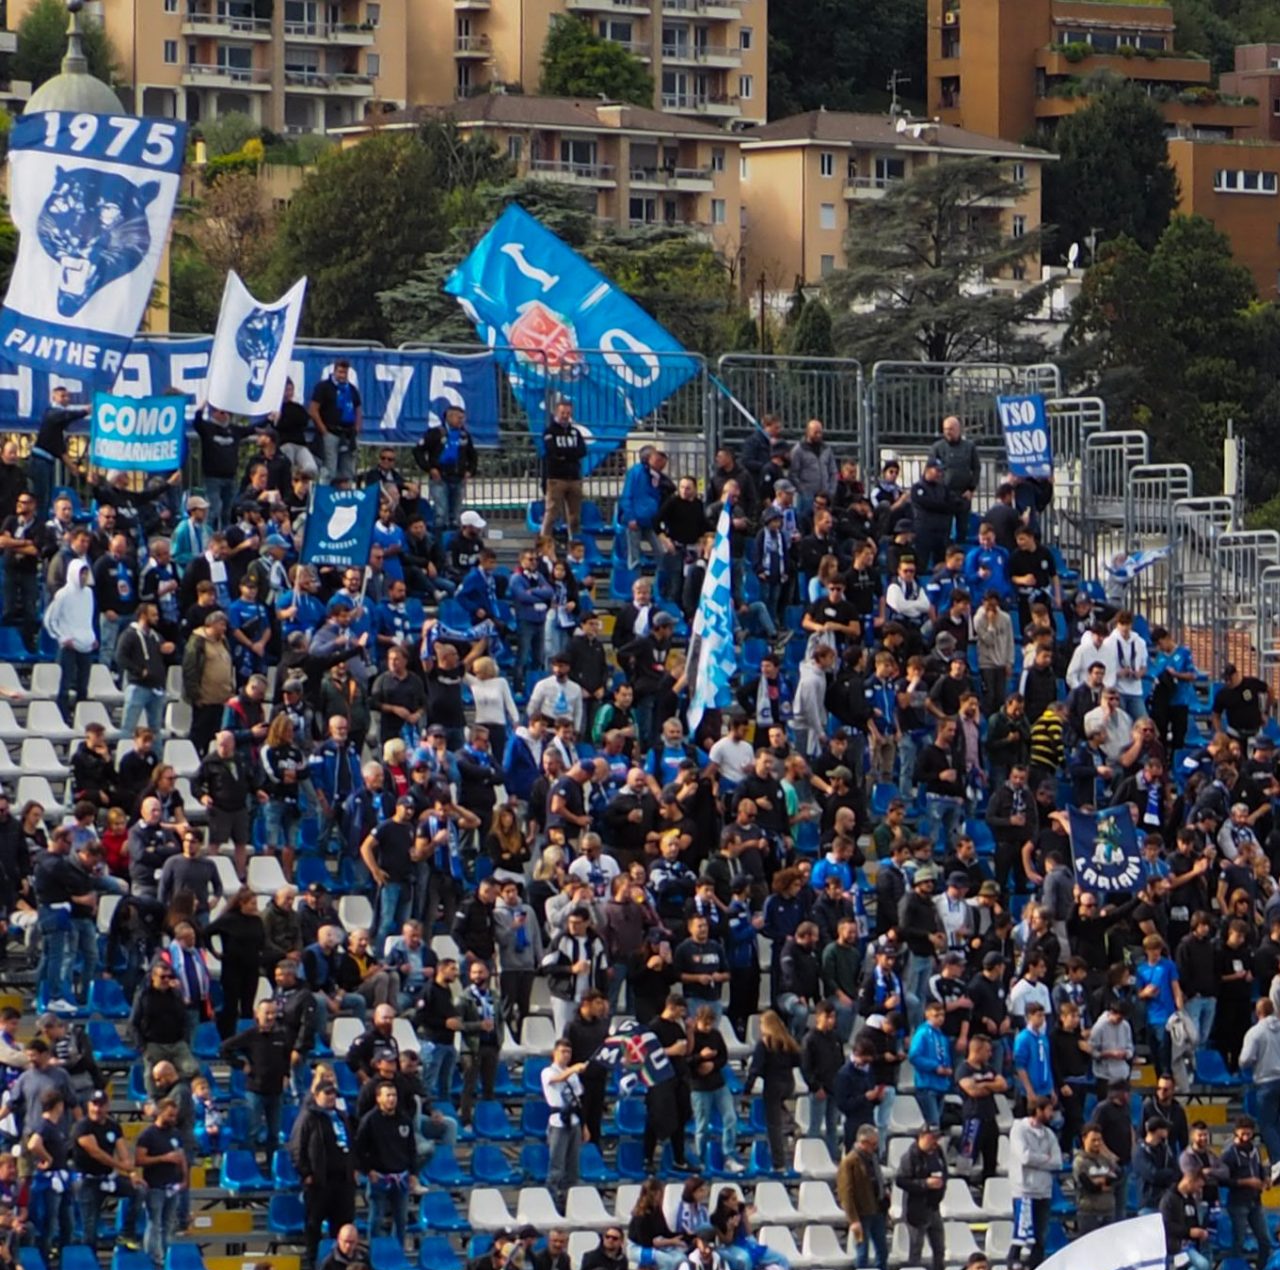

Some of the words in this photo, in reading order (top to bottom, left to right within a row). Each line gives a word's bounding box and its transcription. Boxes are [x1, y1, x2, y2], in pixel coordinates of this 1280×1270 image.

[44, 111, 177, 166] 1975
[98, 402, 177, 436] COMO
[1076, 856, 1140, 890] LARIANI
